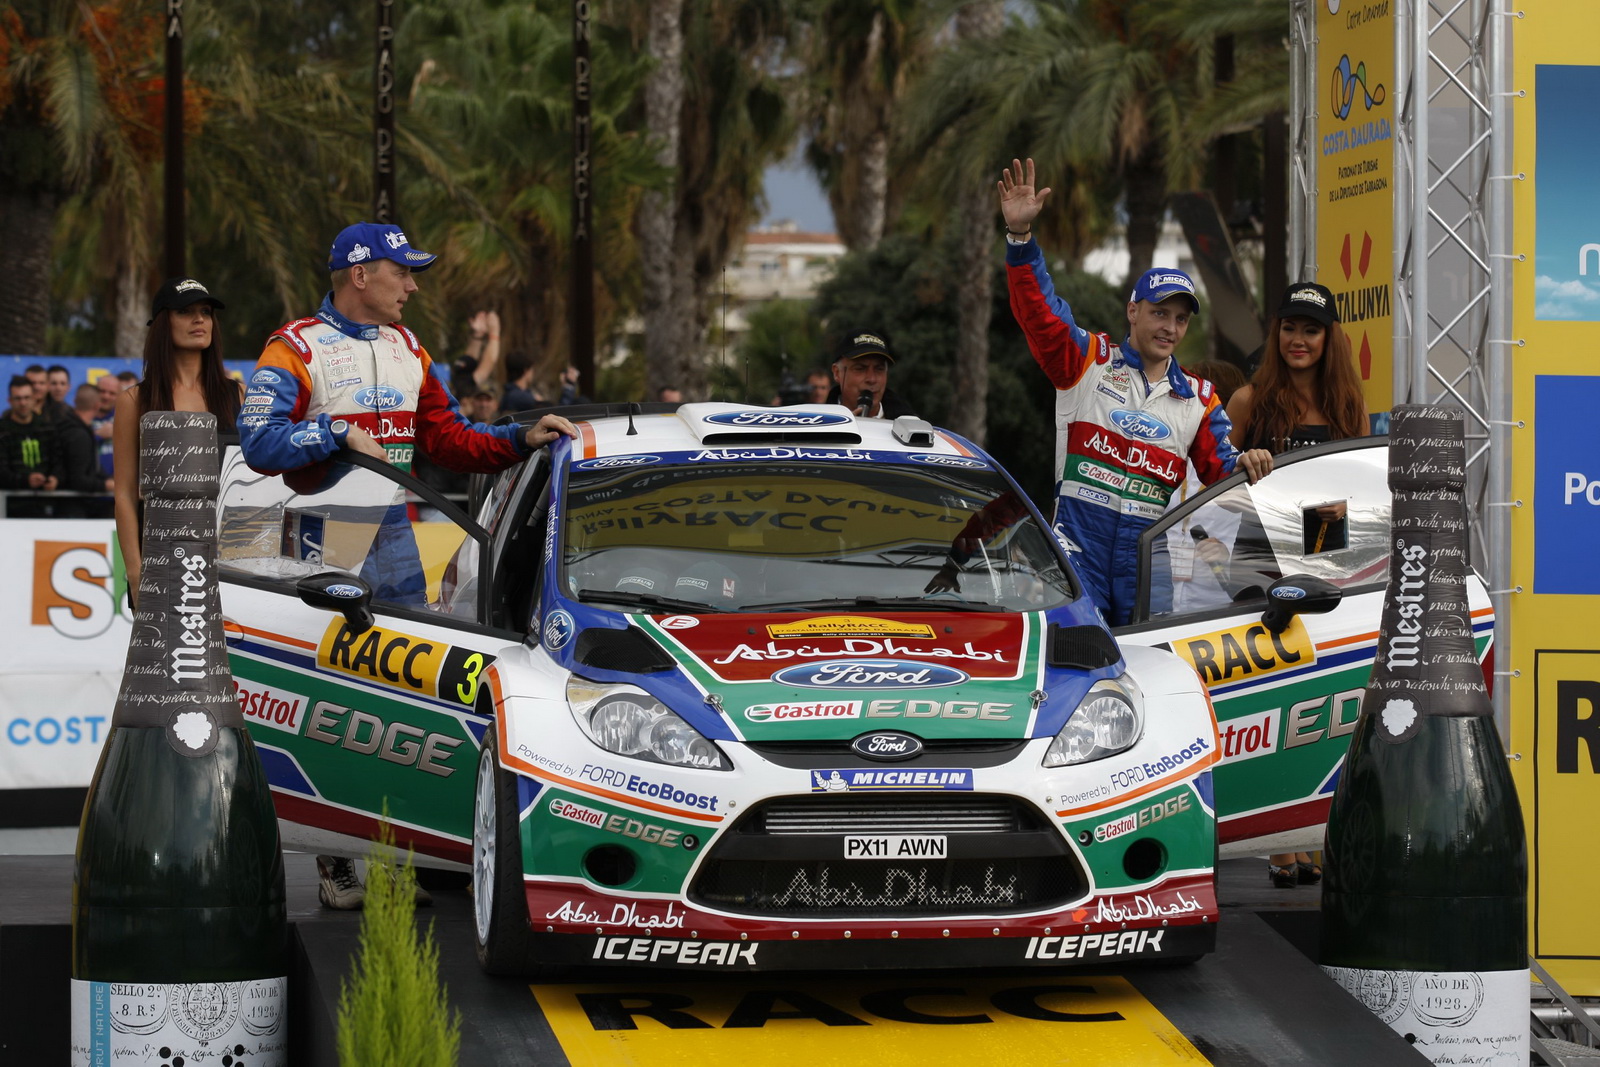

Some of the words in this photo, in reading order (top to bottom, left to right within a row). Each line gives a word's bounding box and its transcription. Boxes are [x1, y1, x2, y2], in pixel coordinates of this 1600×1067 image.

[1322, 129, 1350, 156] COSTA
[1351, 118, 1392, 150] DAURADA
[1333, 284, 1391, 325] TALUNYA
[330, 355, 353, 367] Castrol
[241, 406, 274, 415] EDGE
[250, 396, 272, 404] Castrol
[363, 388, 397, 407] Ford
[732, 411, 824, 425] Ford
[1119, 410, 1160, 438] Ford
[596, 455, 647, 468] Ford
[765, 447, 875, 462] Dhabi
[922, 455, 976, 468] Ford
[1126, 446, 1179, 483] Dhabi
[1088, 466, 1125, 488] Castrol
[1126, 479, 1172, 501] EDGE
[330, 585, 357, 598] Ford
[1276, 587, 1299, 599] Ford
[171, 554, 207, 684] Mestres
[1386, 544, 1427, 672] Mestres
[545, 614, 568, 646] Ford
[329, 622, 434, 689] RACC
[456, 652, 484, 705] 3
[842, 638, 1010, 663] Dhabi
[1187, 625, 1301, 683] RACC
[810, 663, 932, 685] Ford
[774, 702, 855, 719] Castrol
[865, 700, 1016, 721] EDGE
[1220, 715, 1271, 758] trol
[1283, 686, 1367, 750] ED
[304, 700, 466, 779] EDGE
[868, 736, 907, 752] Ford
[683, 754, 721, 768] PIAA
[1051, 751, 1085, 764] PIAA
[517, 743, 562, 772] Powered
[563, 761, 578, 777] by
[579, 764, 627, 788] FORD
[626, 774, 719, 812] EcoBoost
[852, 772, 966, 785] MICHELIN
[1060, 786, 1101, 806] Powered
[1101, 784, 1111, 797] by
[1110, 766, 1146, 791] FORD
[1143, 736, 1210, 779] EcoBoost
[562, 803, 602, 826] Castrol
[603, 814, 685, 849] EDGE
[1106, 816, 1136, 838] Castrol
[1137, 791, 1192, 829] EDGE
[848, 838, 888, 856] PX11
[897, 838, 944, 856] AWN
[879, 863, 1017, 907] Dhabi
[609, 901, 687, 929] Dhabi
[1134, 891, 1204, 920] Dhabi
[592, 937, 759, 966] ICEPEAK
[1024, 929, 1165, 960] ICEPEAK
[110, 983, 144, 998] SELLO
[1419, 973, 1448, 990] AÑO
[1451, 978, 1470, 991] DE
[95, 985, 104, 1036] NATURE
[574, 984, 1128, 1031] RACC
